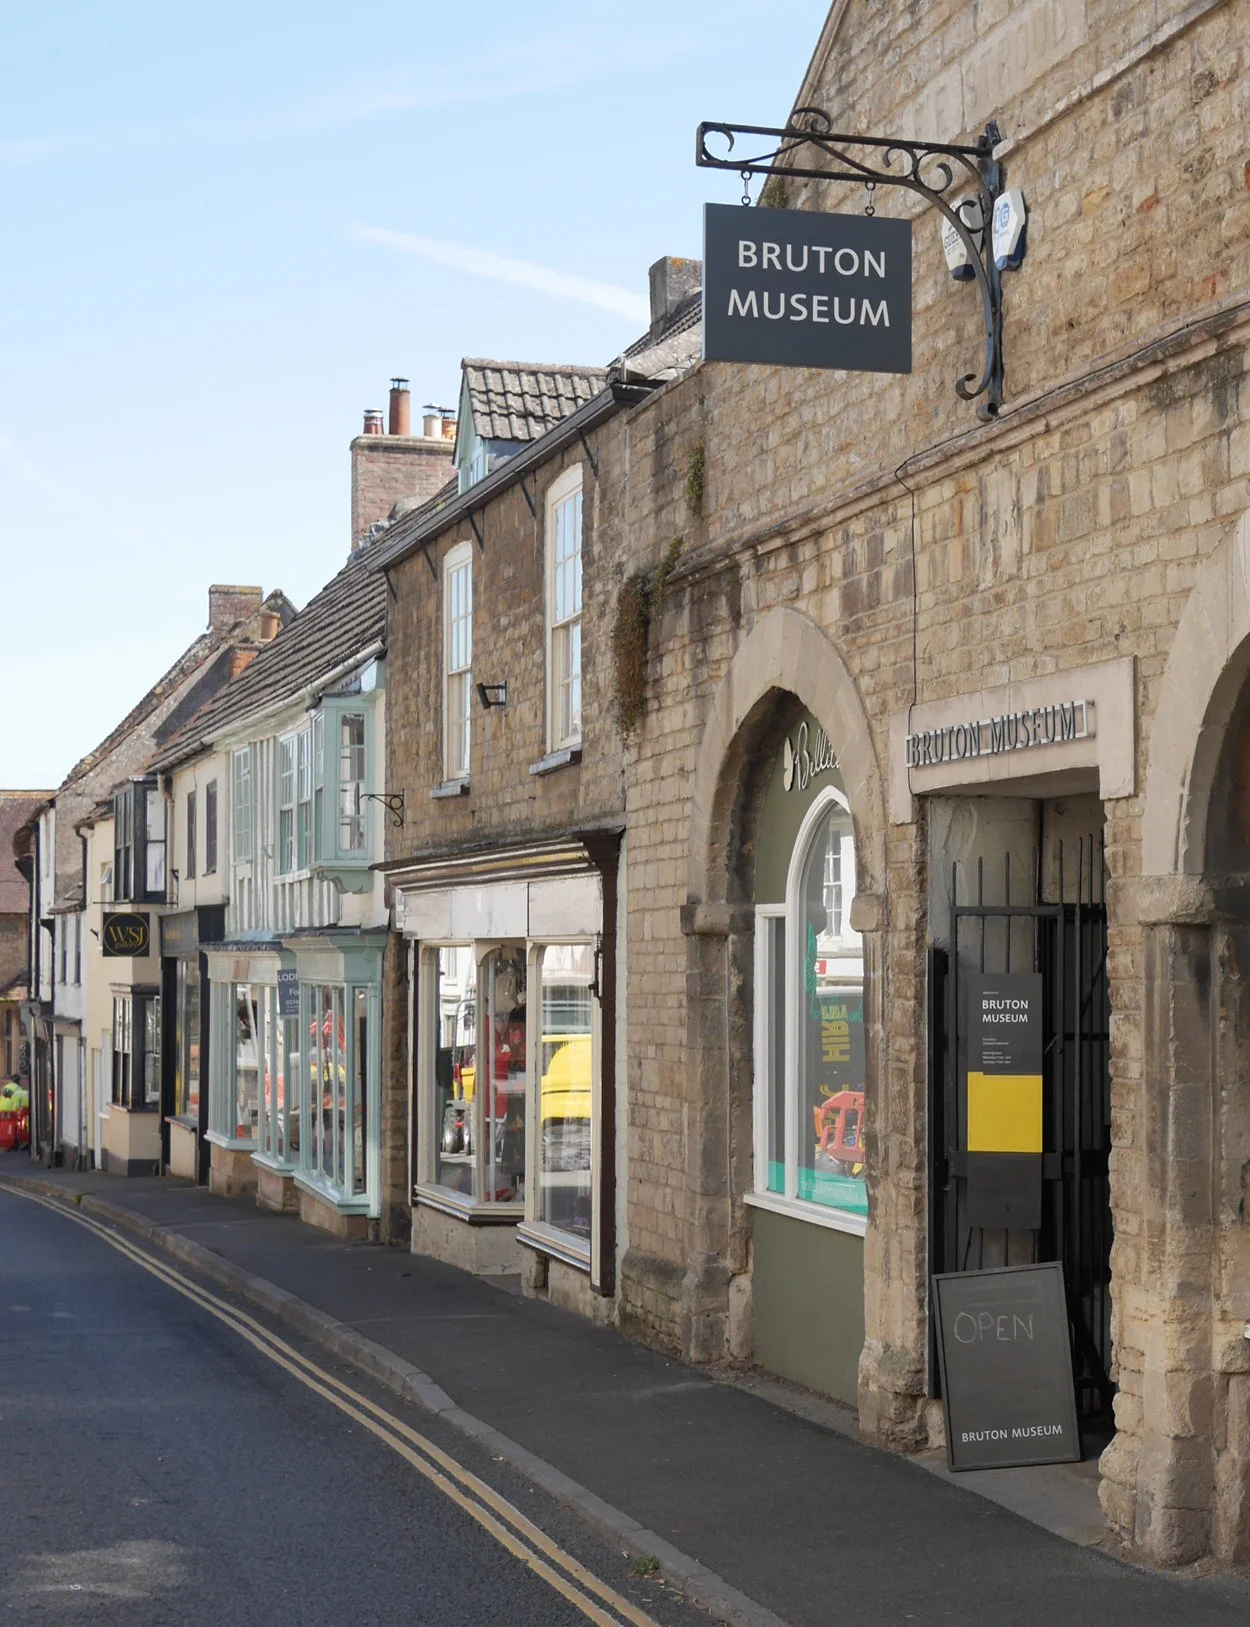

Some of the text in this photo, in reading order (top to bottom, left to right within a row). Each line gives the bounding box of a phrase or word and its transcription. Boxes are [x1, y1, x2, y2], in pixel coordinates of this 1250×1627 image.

[738, 240, 886, 278] BRUTON
[727, 289, 890, 327] MUSEUM
[911, 701, 1077, 767] BRUTON MUSEUM
[109, 926, 144, 946] WSJ
[982, 1000, 1029, 1010] BRUTON
[982, 1013, 1029, 1023] MUSEUM
[954, 1312, 1034, 1344] OPEN
[962, 1425, 1063, 1443] BRUTON MUSEUM
